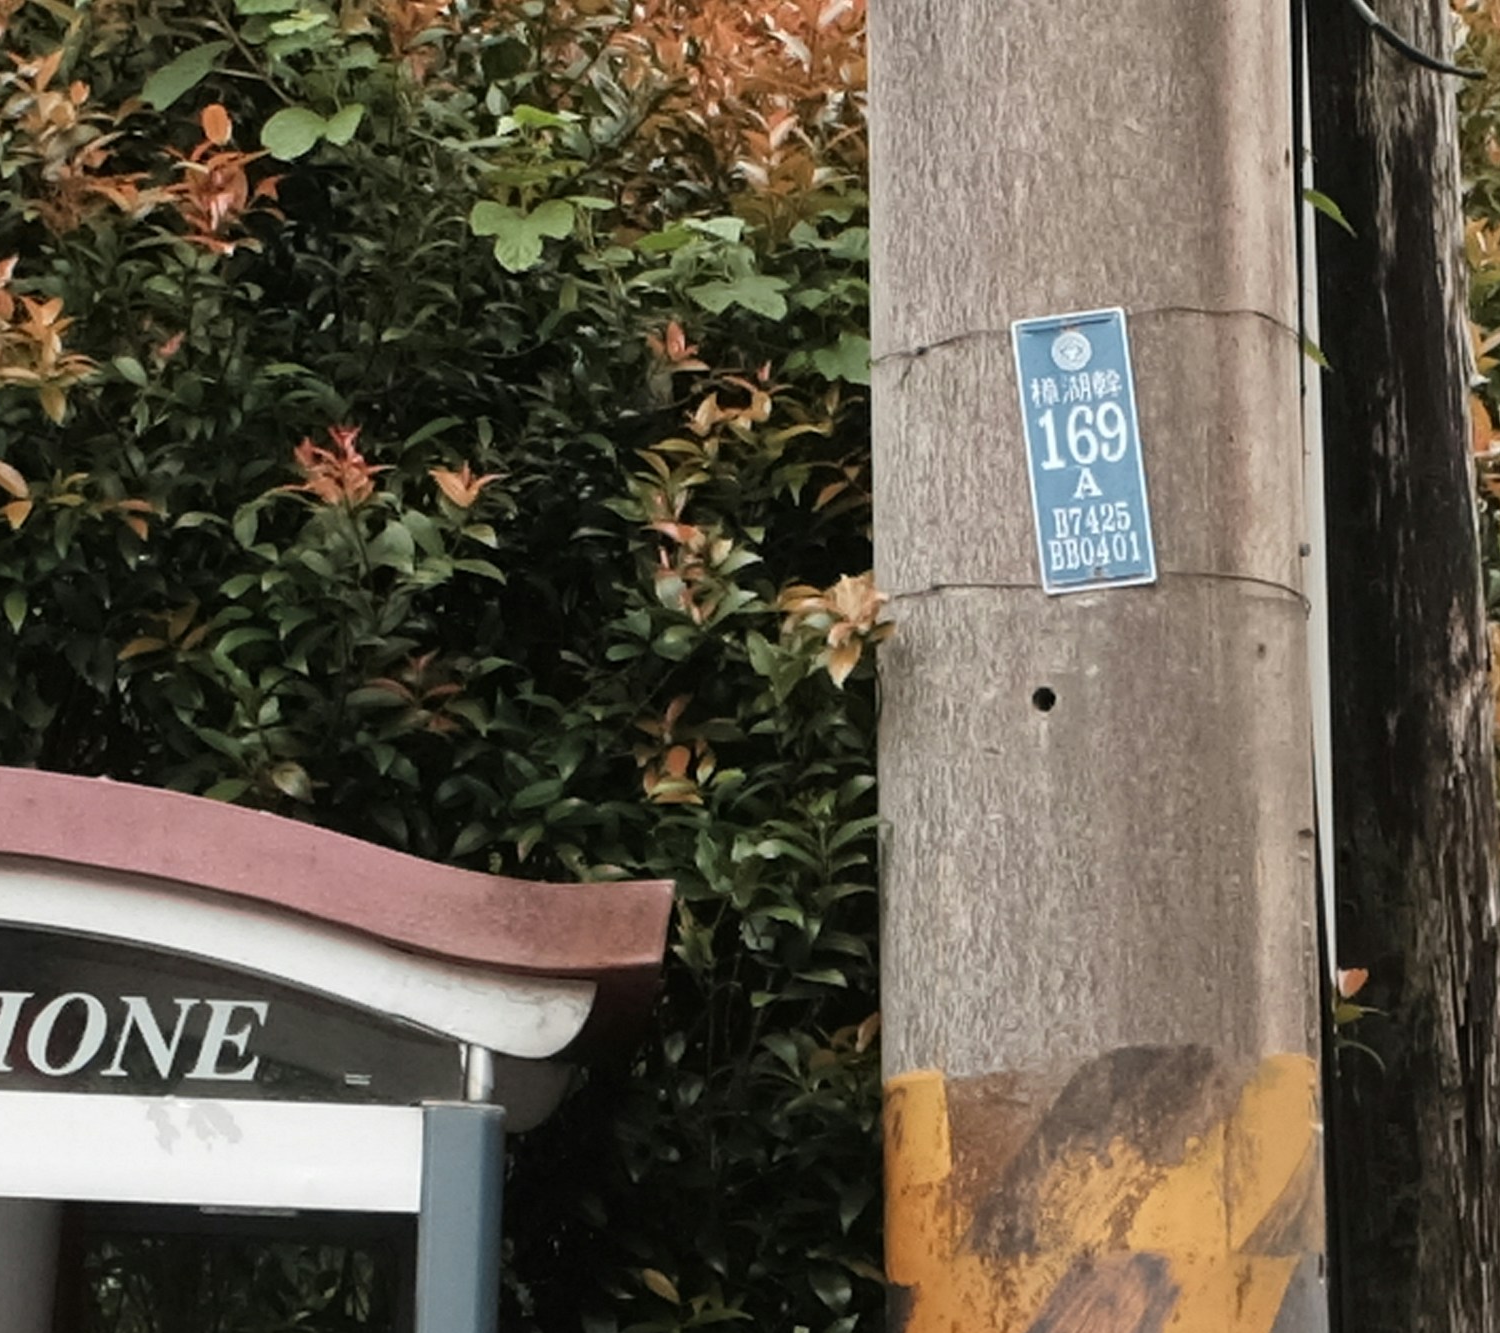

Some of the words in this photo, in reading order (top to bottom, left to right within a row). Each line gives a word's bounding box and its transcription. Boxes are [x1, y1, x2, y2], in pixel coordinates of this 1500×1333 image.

[1038, 401, 1128, 470] 169
[1072, 467, 1103, 499] A
[1052, 500, 1131, 540] B7425
[1047, 532, 1141, 572] BB0401
